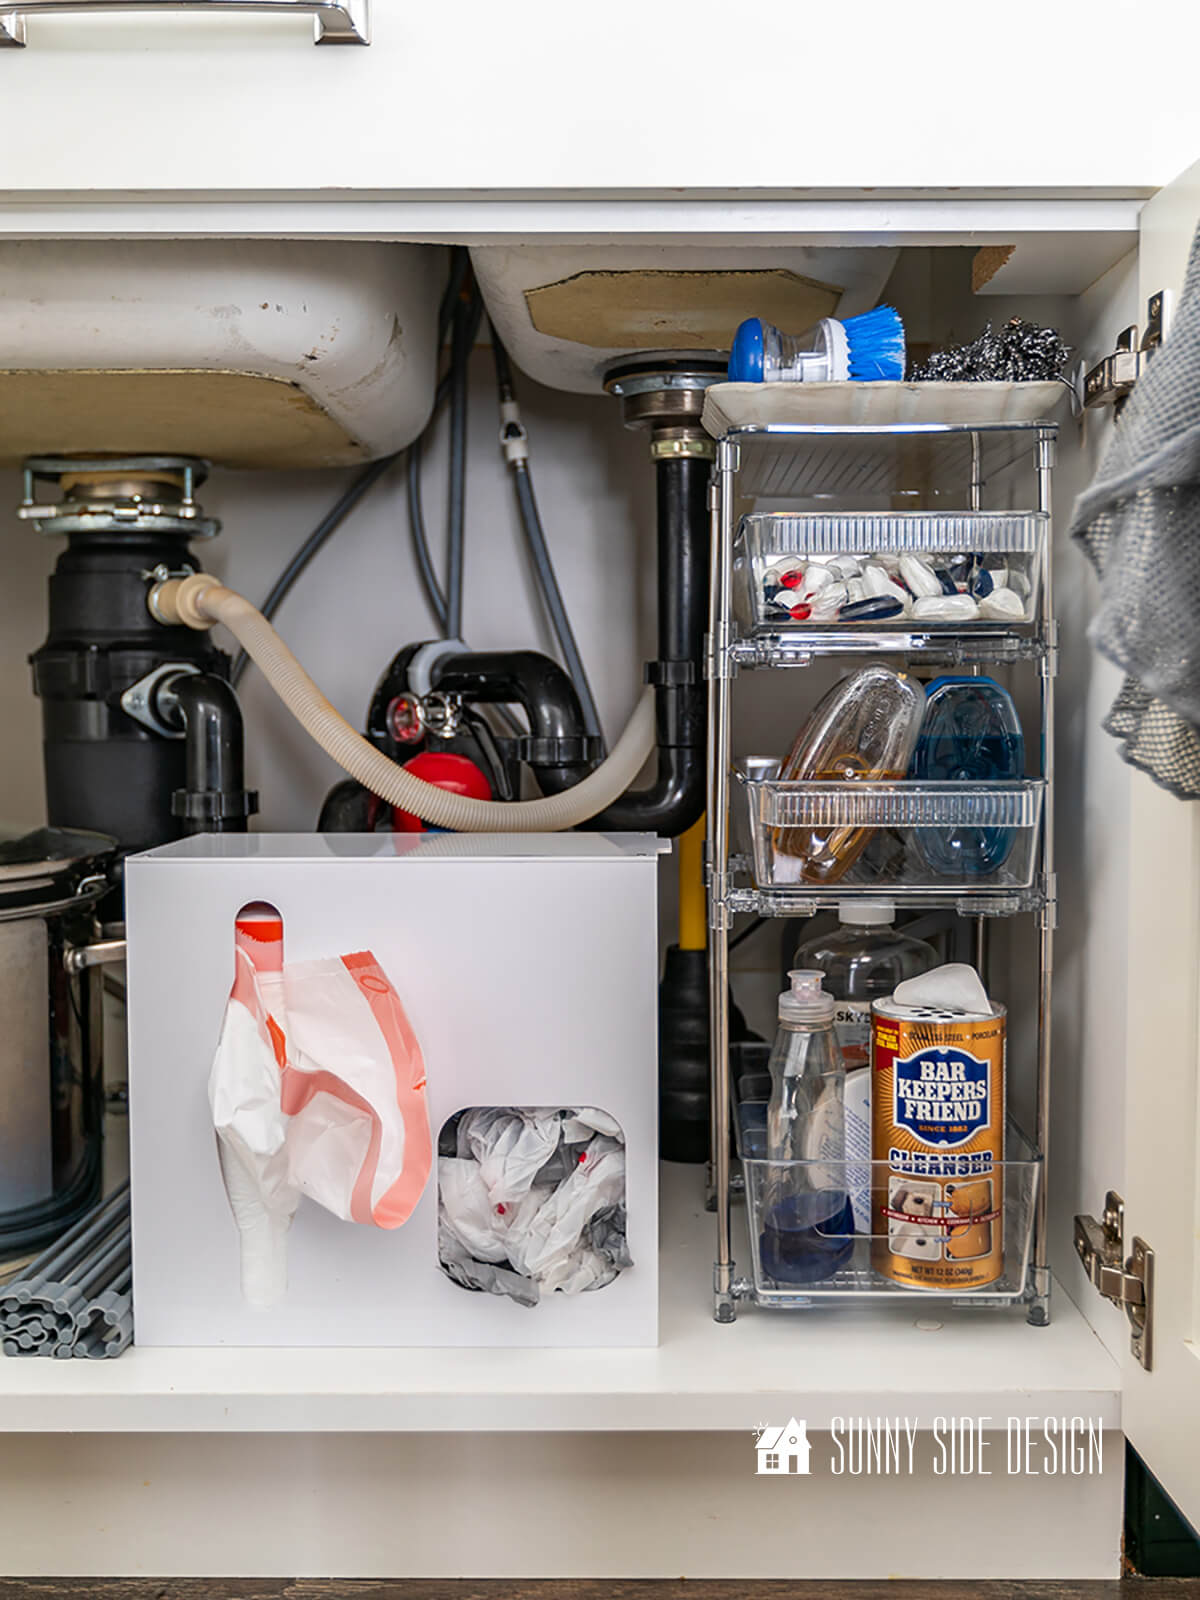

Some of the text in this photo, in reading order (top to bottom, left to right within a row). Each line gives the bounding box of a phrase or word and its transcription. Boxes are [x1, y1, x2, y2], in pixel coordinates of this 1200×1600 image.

[919, 1061, 966, 1081] BAR
[898, 1078, 986, 1101] KEEPERS
[904, 1099, 982, 1121] FRIEND
[889, 1148, 994, 1176] CLEANSER
